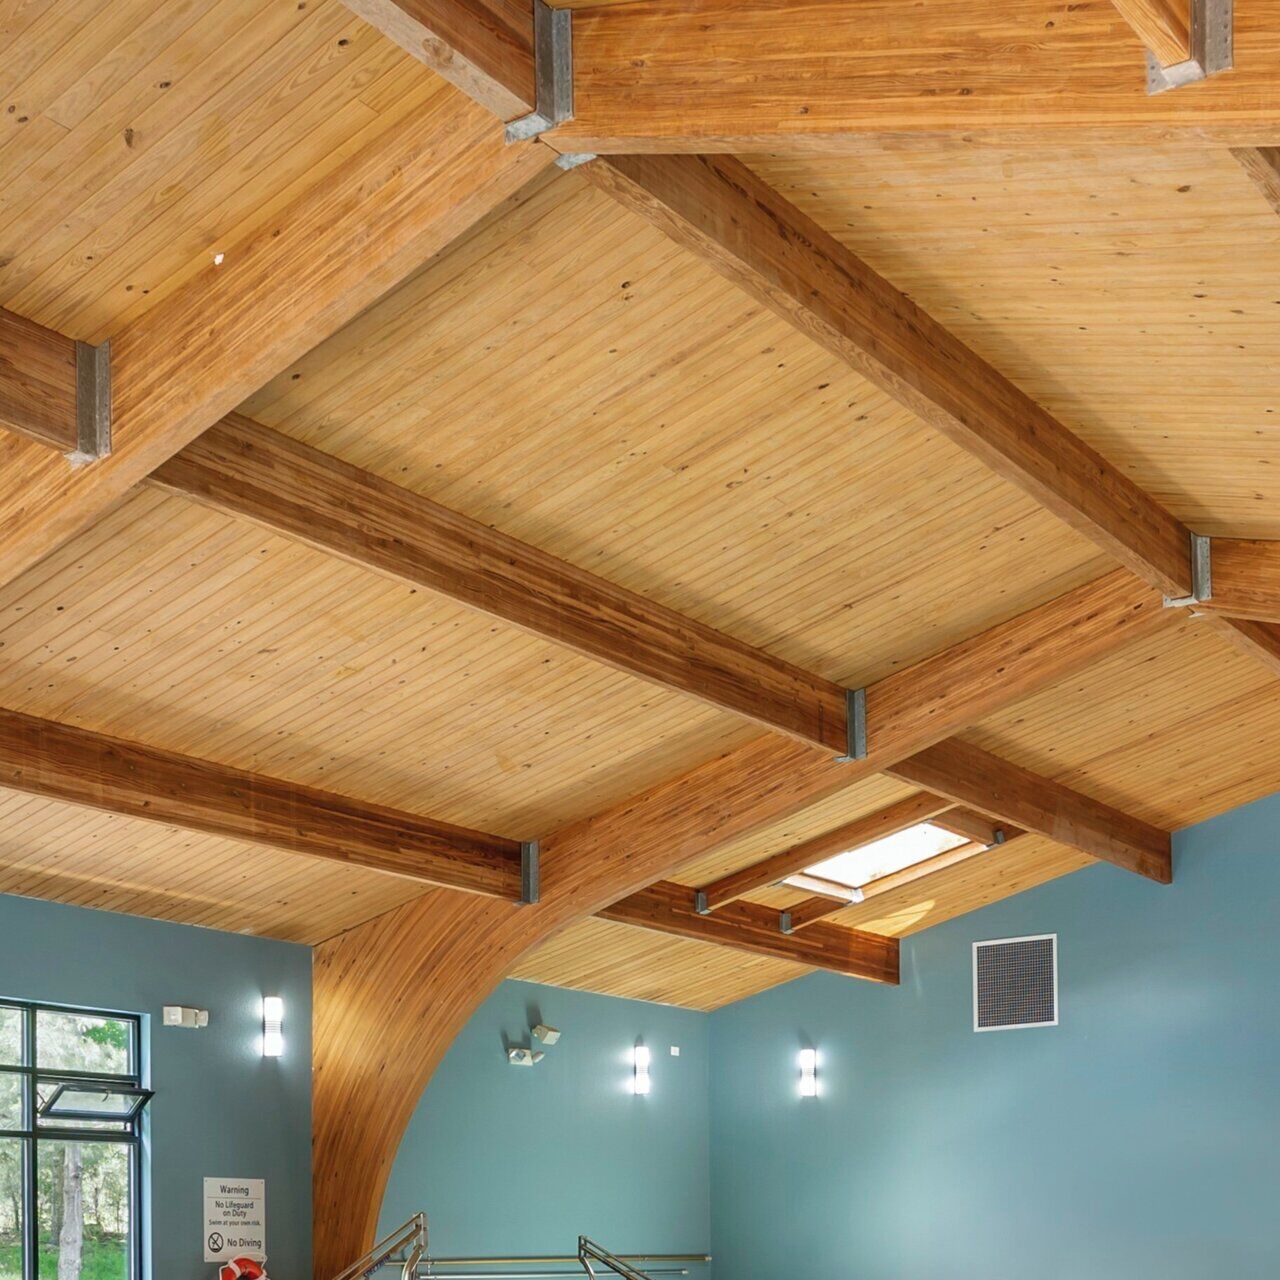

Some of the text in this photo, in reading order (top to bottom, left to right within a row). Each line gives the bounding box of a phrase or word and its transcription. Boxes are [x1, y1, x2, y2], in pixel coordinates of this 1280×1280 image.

[220, 1185, 249, 1196] Warning
[225, 1201, 254, 1210] Lifeguard
[232, 1210, 247, 1218] Duty
[227, 1238, 262, 1249] No Diving
